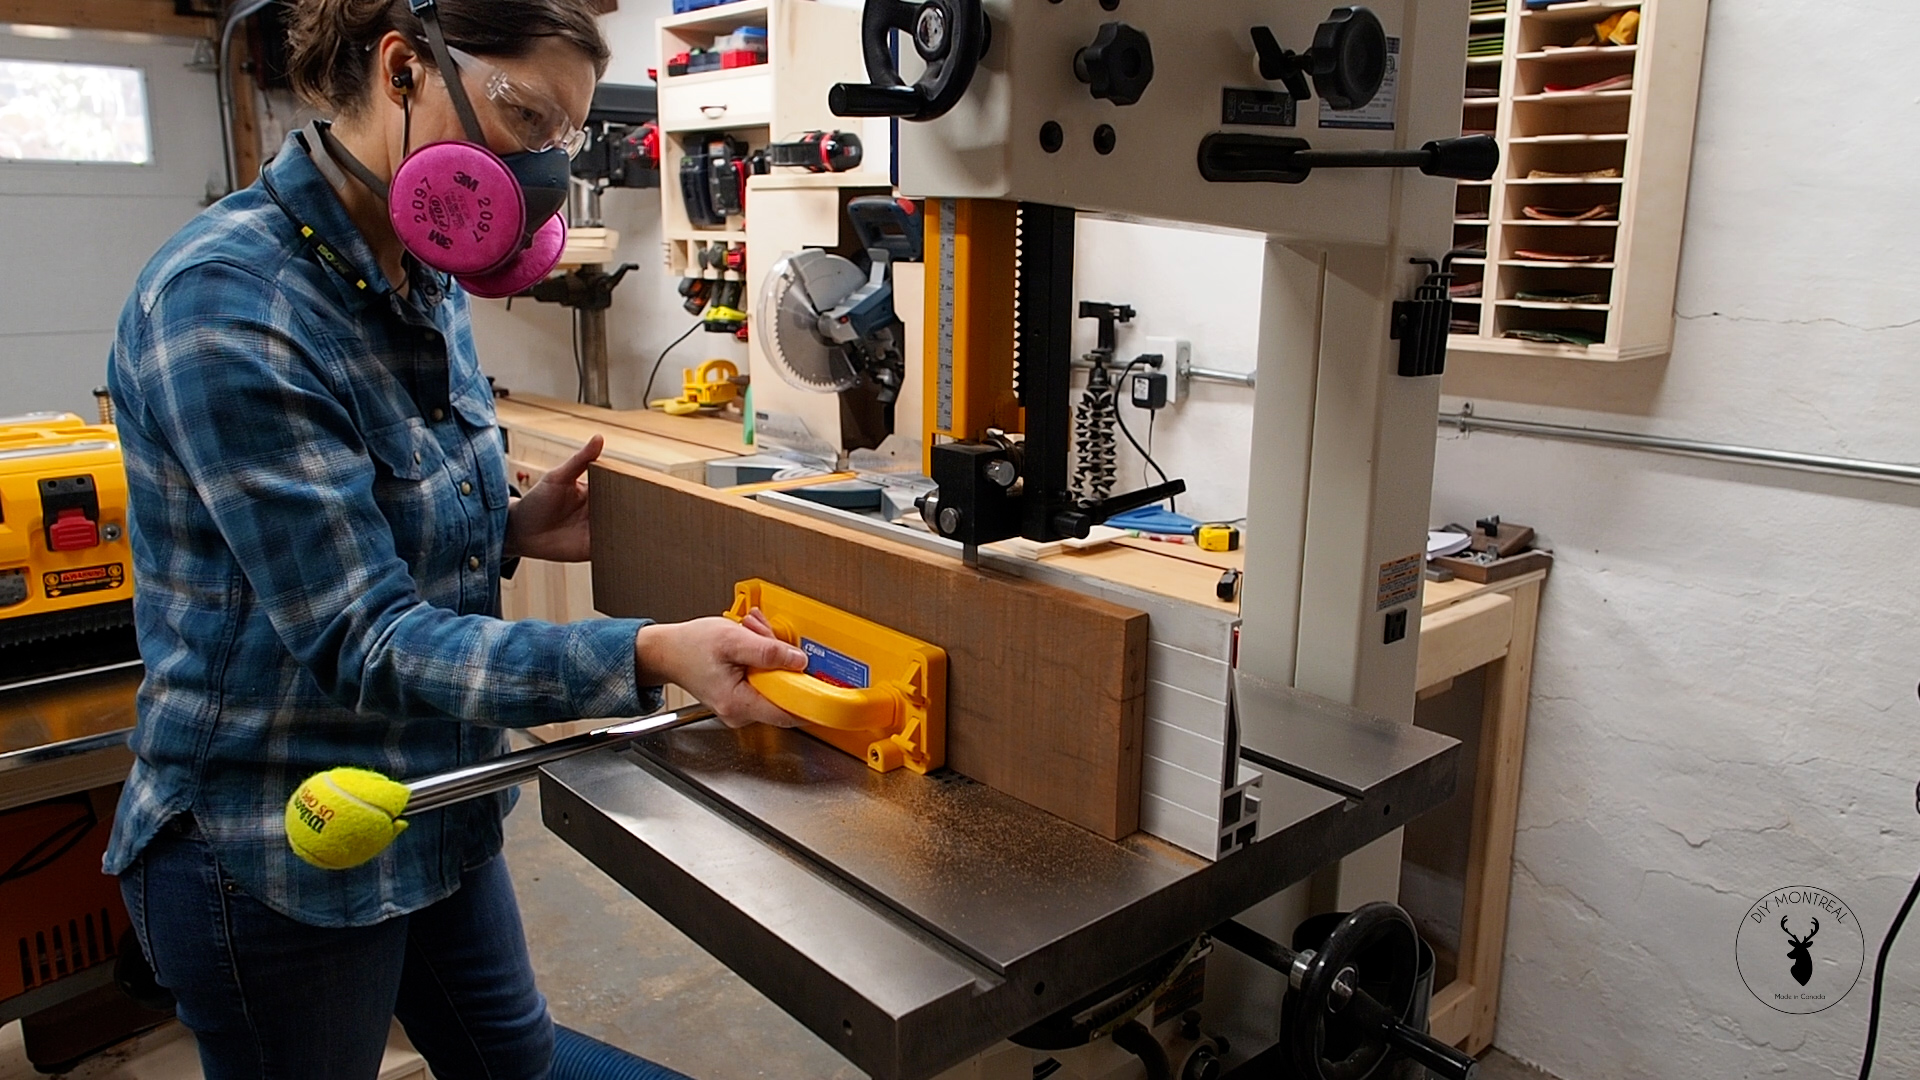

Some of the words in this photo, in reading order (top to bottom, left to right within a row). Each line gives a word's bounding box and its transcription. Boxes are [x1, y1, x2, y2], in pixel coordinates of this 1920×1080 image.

[453, 171, 480, 192] 3M
[412, 176, 432, 223] 2097
[472, 197, 494, 243] 2097
[428, 229, 454, 250] 3M
